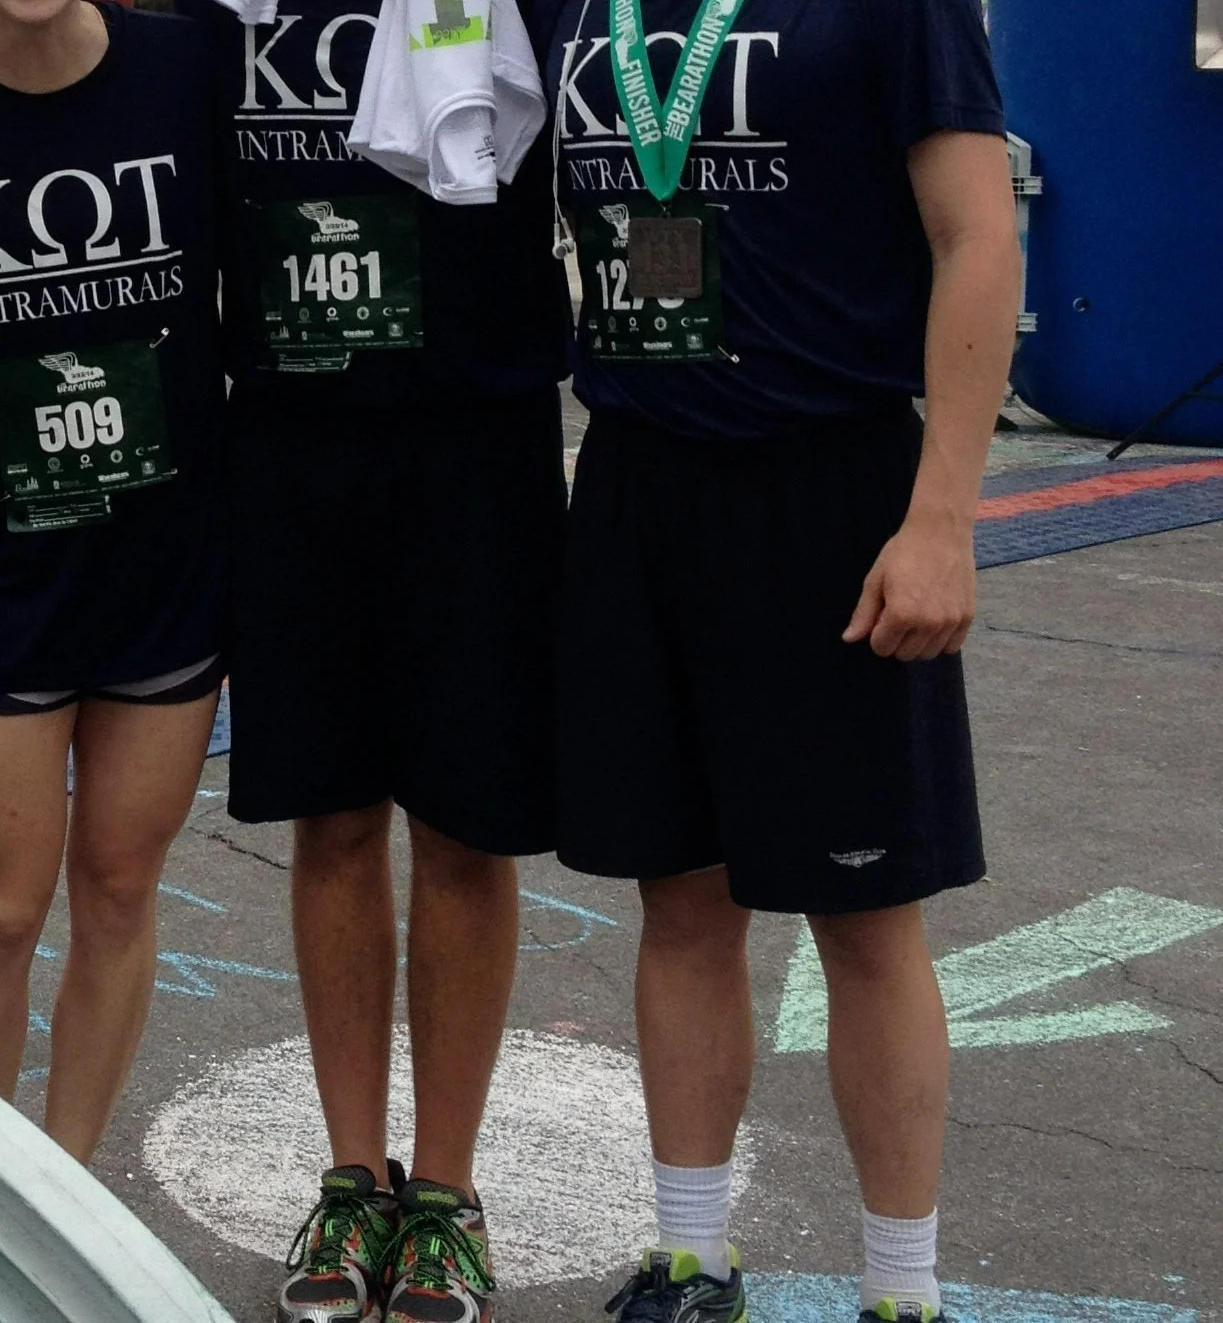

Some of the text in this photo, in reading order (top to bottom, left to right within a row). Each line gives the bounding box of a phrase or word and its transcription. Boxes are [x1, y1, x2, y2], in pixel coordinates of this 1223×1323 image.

[667, 12, 725, 128] BEARATHON
[620, 59, 663, 147] FINISHER
[568, 157, 789, 192] NTRAURALS
[283, 251, 382, 302] 1461
[596, 259, 685, 310] 12
[35, 396, 124, 453] 509
